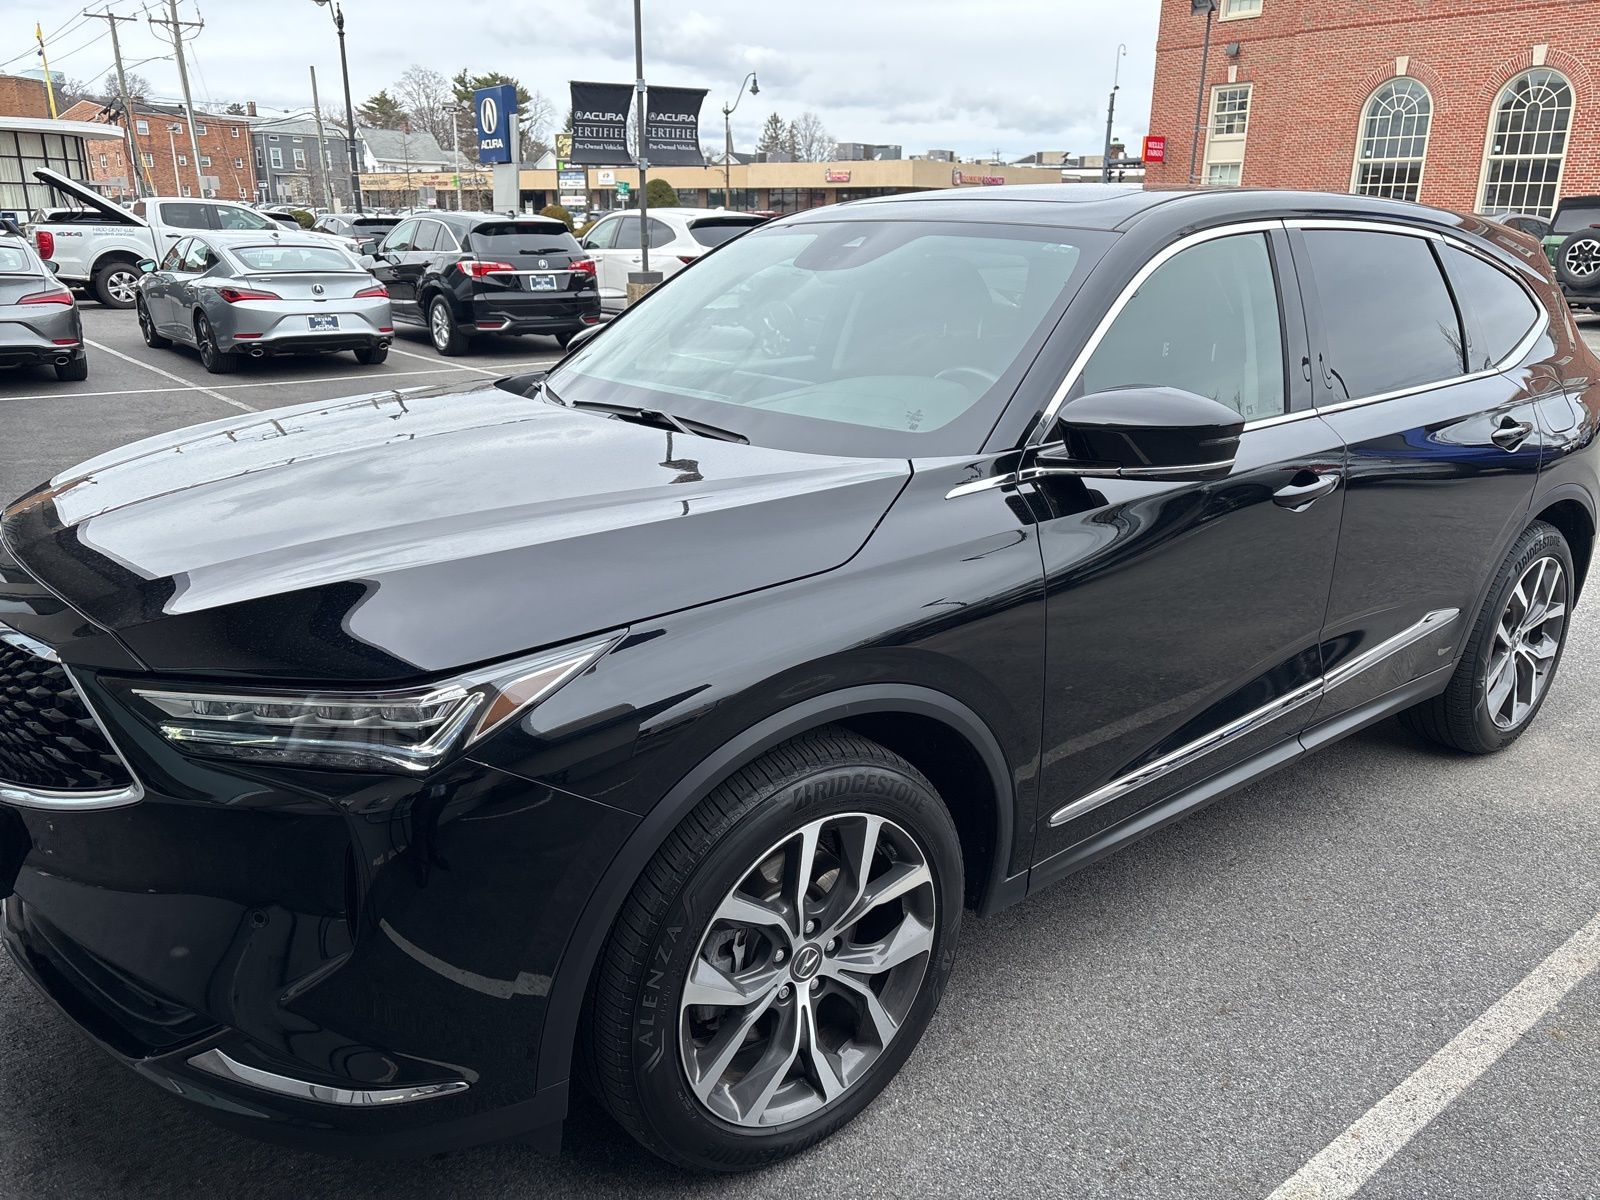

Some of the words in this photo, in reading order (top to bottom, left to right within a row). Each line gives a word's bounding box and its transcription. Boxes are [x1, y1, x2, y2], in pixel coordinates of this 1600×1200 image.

[583, 112, 625, 121] ACURA
[657, 113, 697, 122] ACURA
[480, 138, 504, 150] ACURA
[604, 143, 625, 151] Vehicles
[676, 143, 697, 151] Vehicles
[1147, 141, 1164, 149] WELLS
[1146, 149, 1164, 157] FARGO
[1514, 535, 1561, 577] BRIDGESTONE
[793, 774, 928, 814] BRIDGESTONE
[638, 926, 684, 1047] ALENZA
